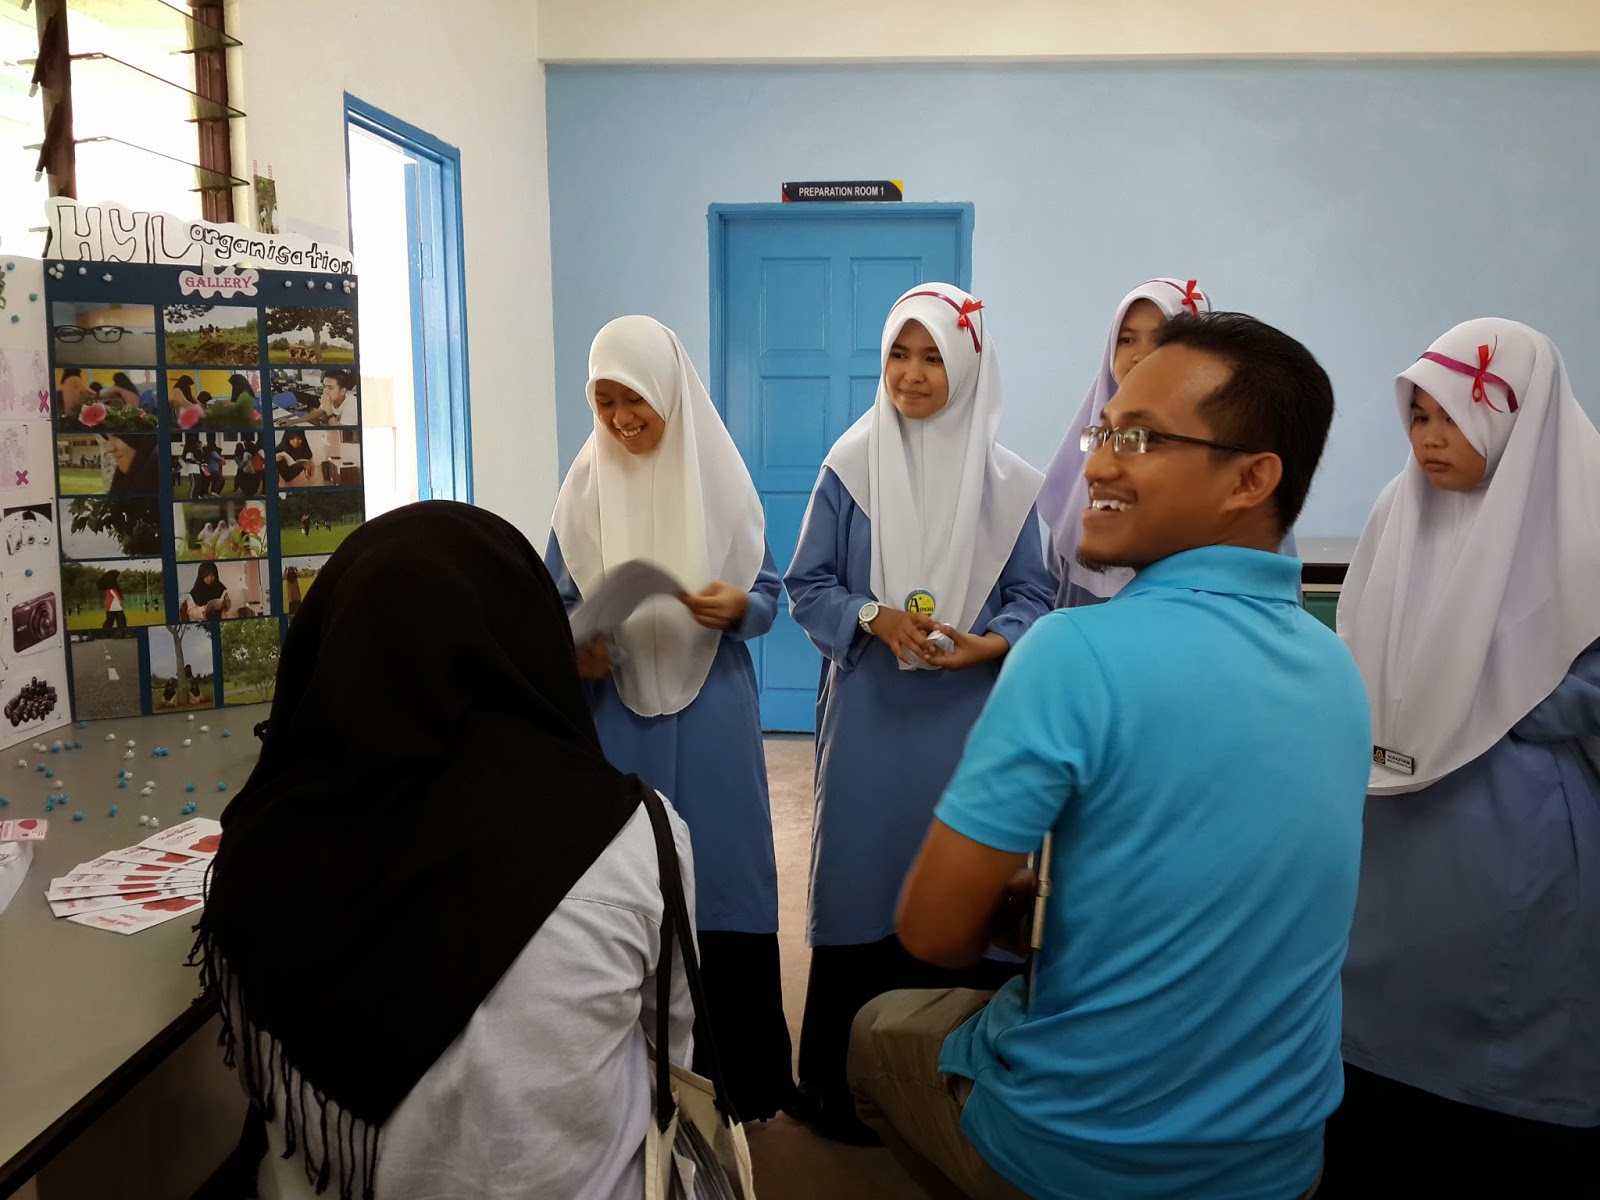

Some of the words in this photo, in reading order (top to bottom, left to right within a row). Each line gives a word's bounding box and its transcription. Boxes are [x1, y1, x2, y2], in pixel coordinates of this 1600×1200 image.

[798, 187, 853, 197] PREPARATION
[854, 186, 879, 196] ROOM
[880, 186, 885, 196] 1
[190, 224, 353, 275] organisation
[185, 275, 252, 289] GALLERY
